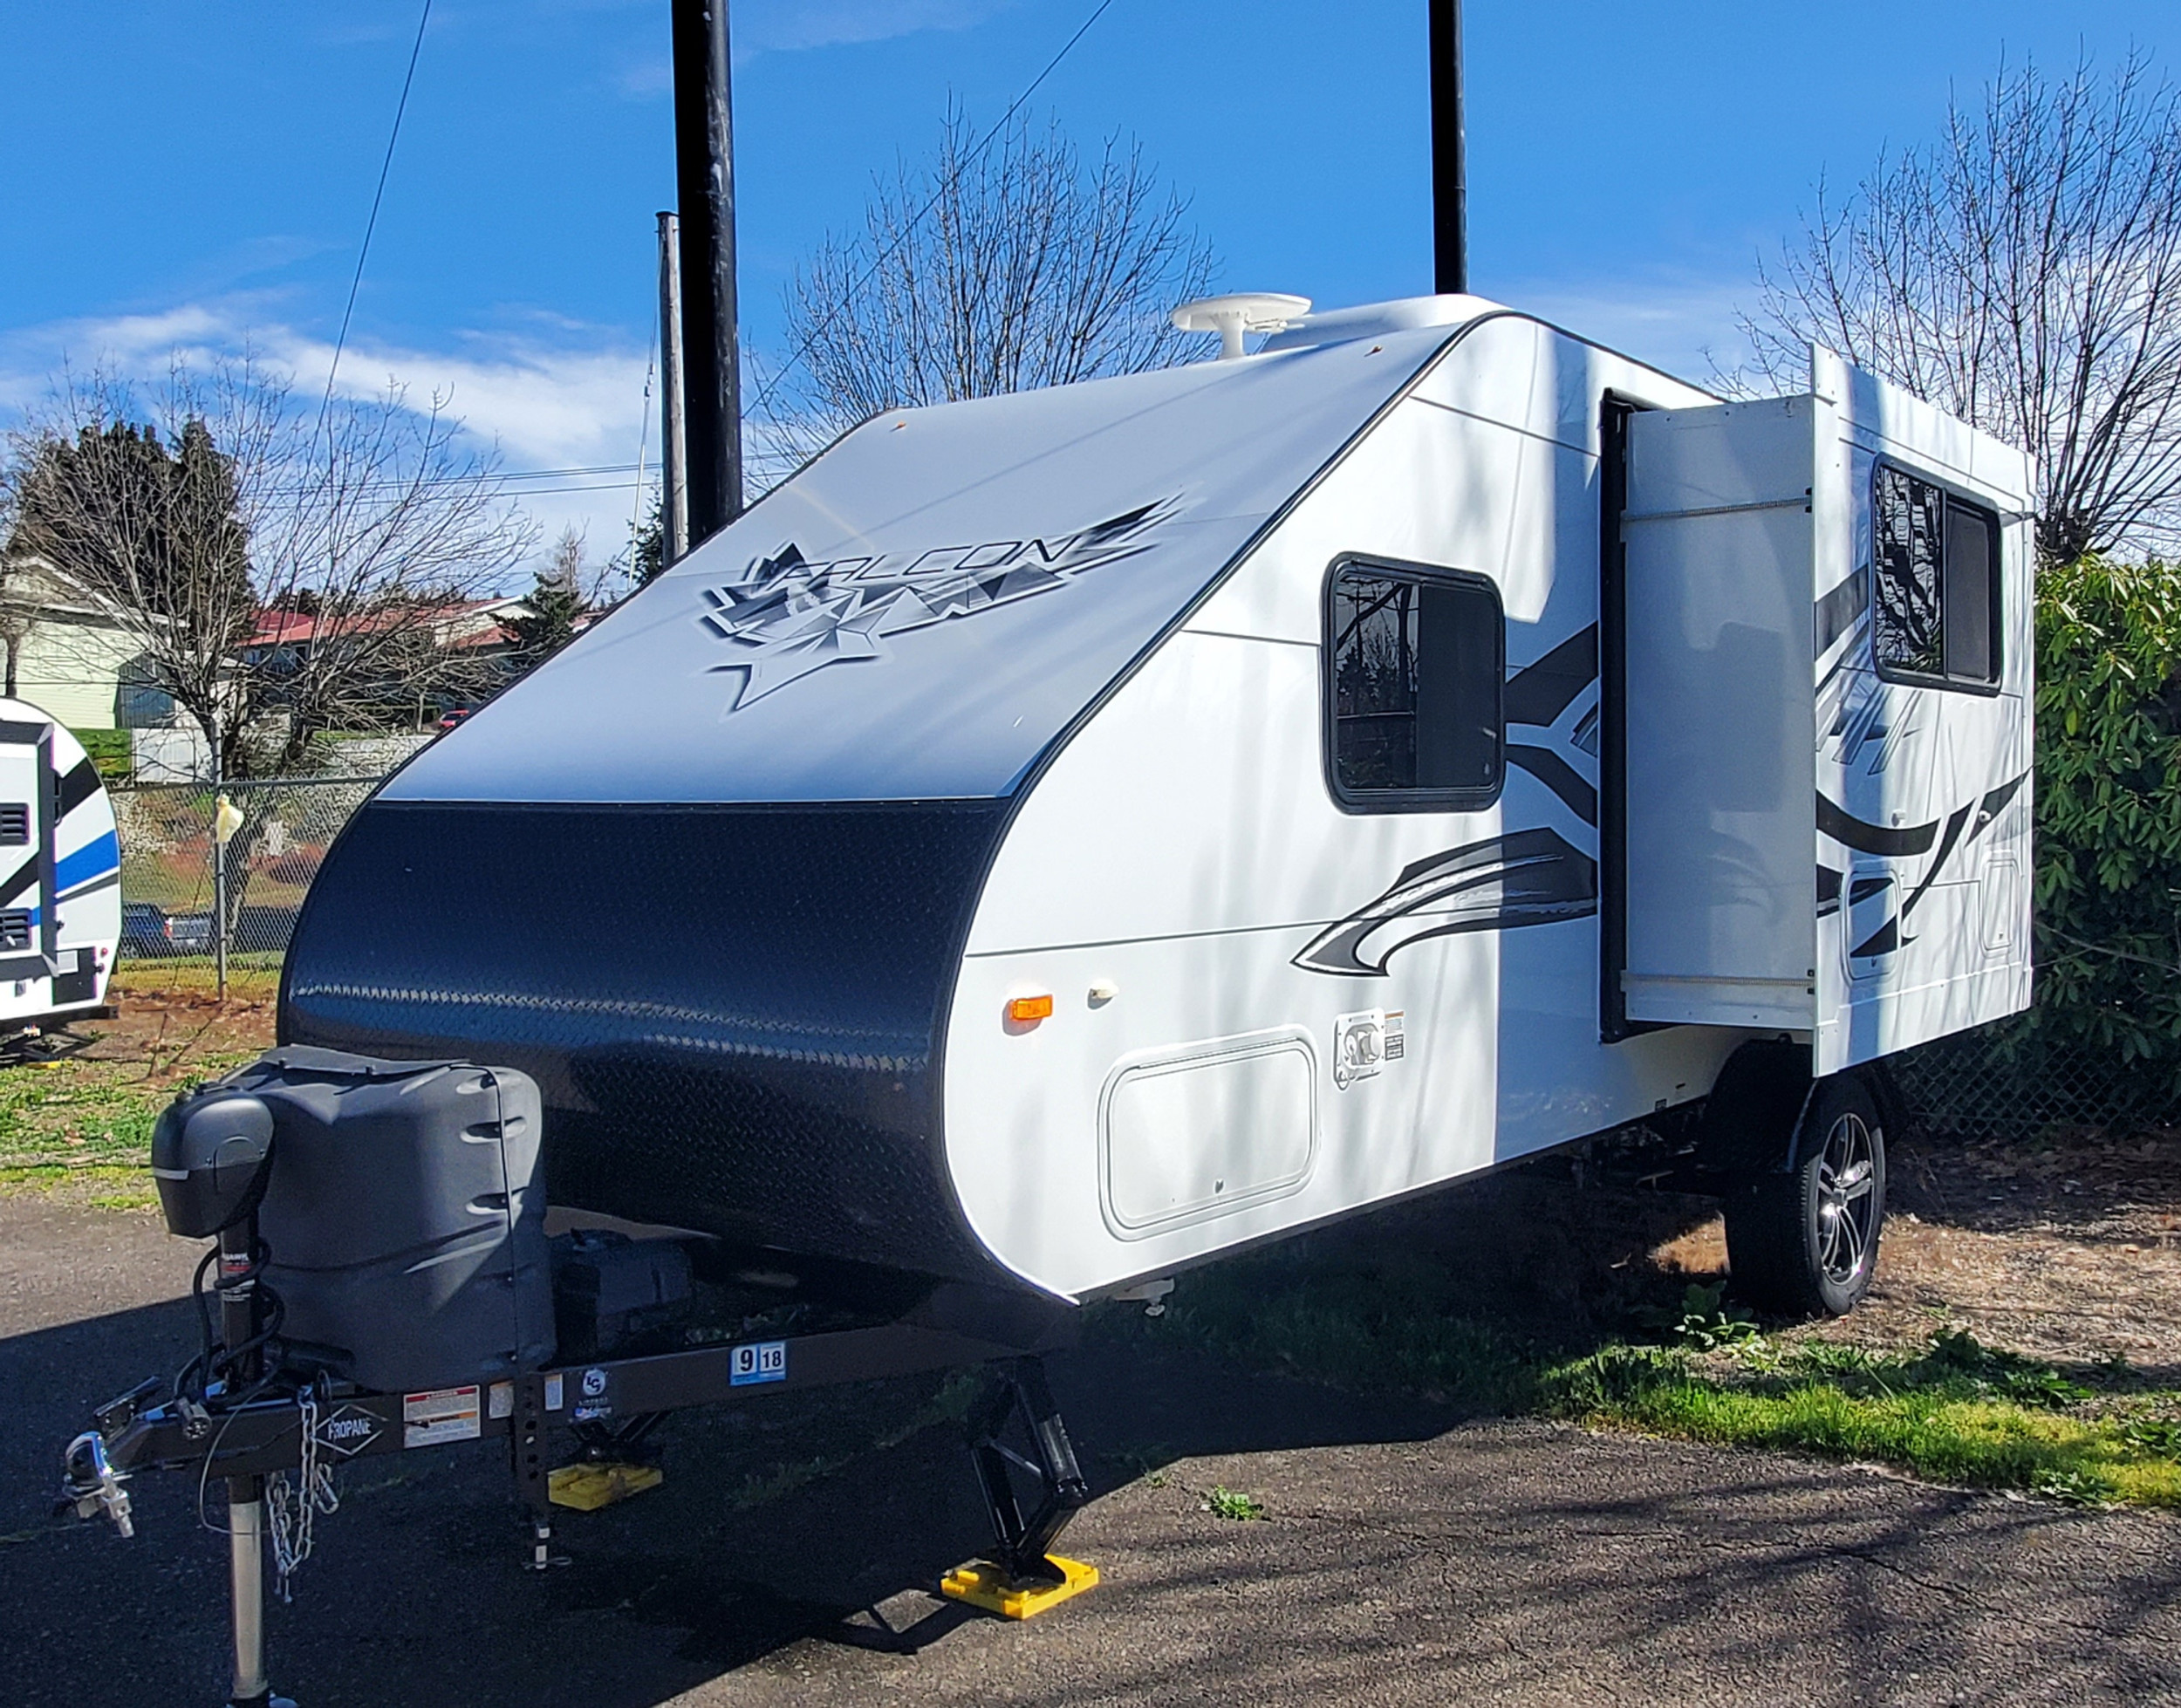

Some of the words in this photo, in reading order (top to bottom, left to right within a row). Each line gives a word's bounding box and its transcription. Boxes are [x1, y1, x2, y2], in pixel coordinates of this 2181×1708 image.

[766, 535, 1082, 591] FALCON
[740, 1349, 754, 1371] 9
[762, 1350, 782, 1369] 18
[327, 1417, 373, 1440] PROPANE
